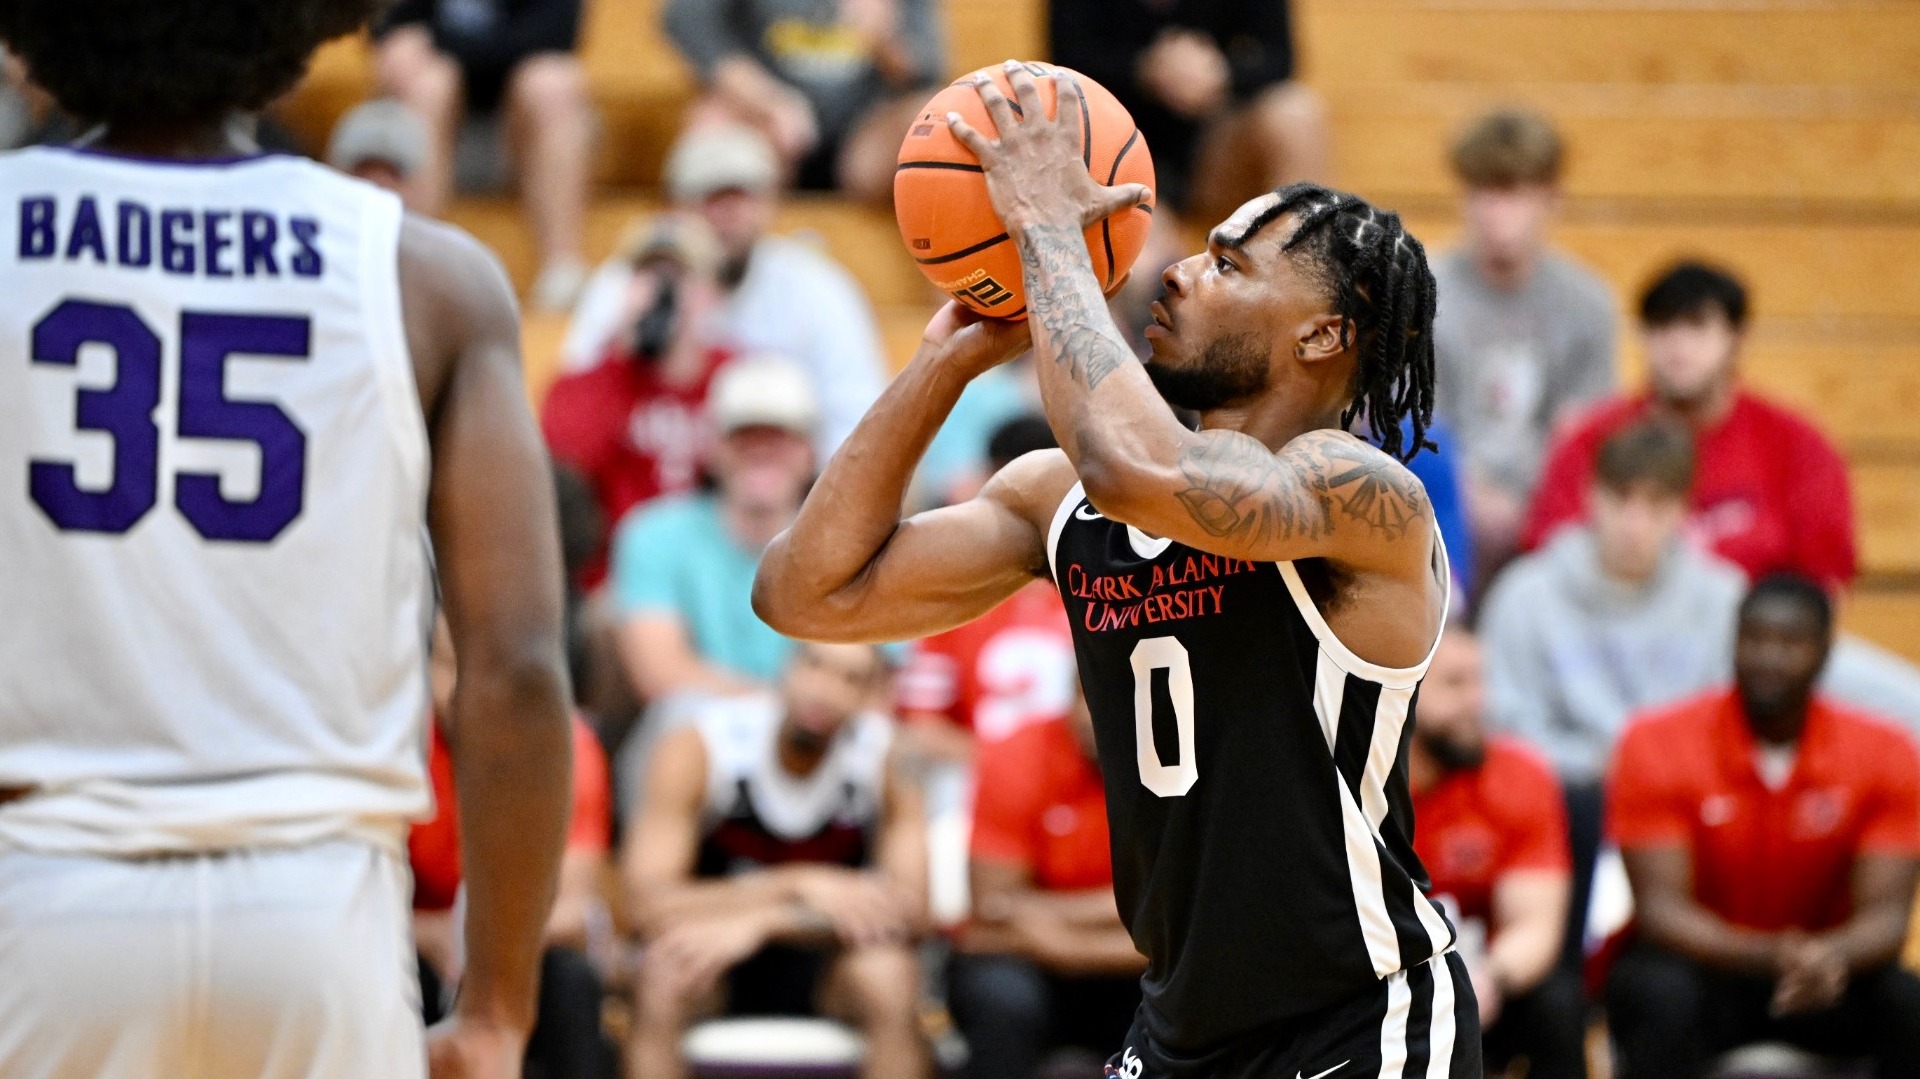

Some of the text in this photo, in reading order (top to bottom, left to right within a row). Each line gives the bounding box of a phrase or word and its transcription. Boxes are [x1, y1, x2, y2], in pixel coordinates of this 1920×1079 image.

[19, 195, 323, 278] BADGERS
[28, 296, 312, 543] 35
[1068, 562, 1143, 601] CLARK
[1084, 584, 1225, 632] UNIVERSITY
[1130, 635, 1199, 798] 0
